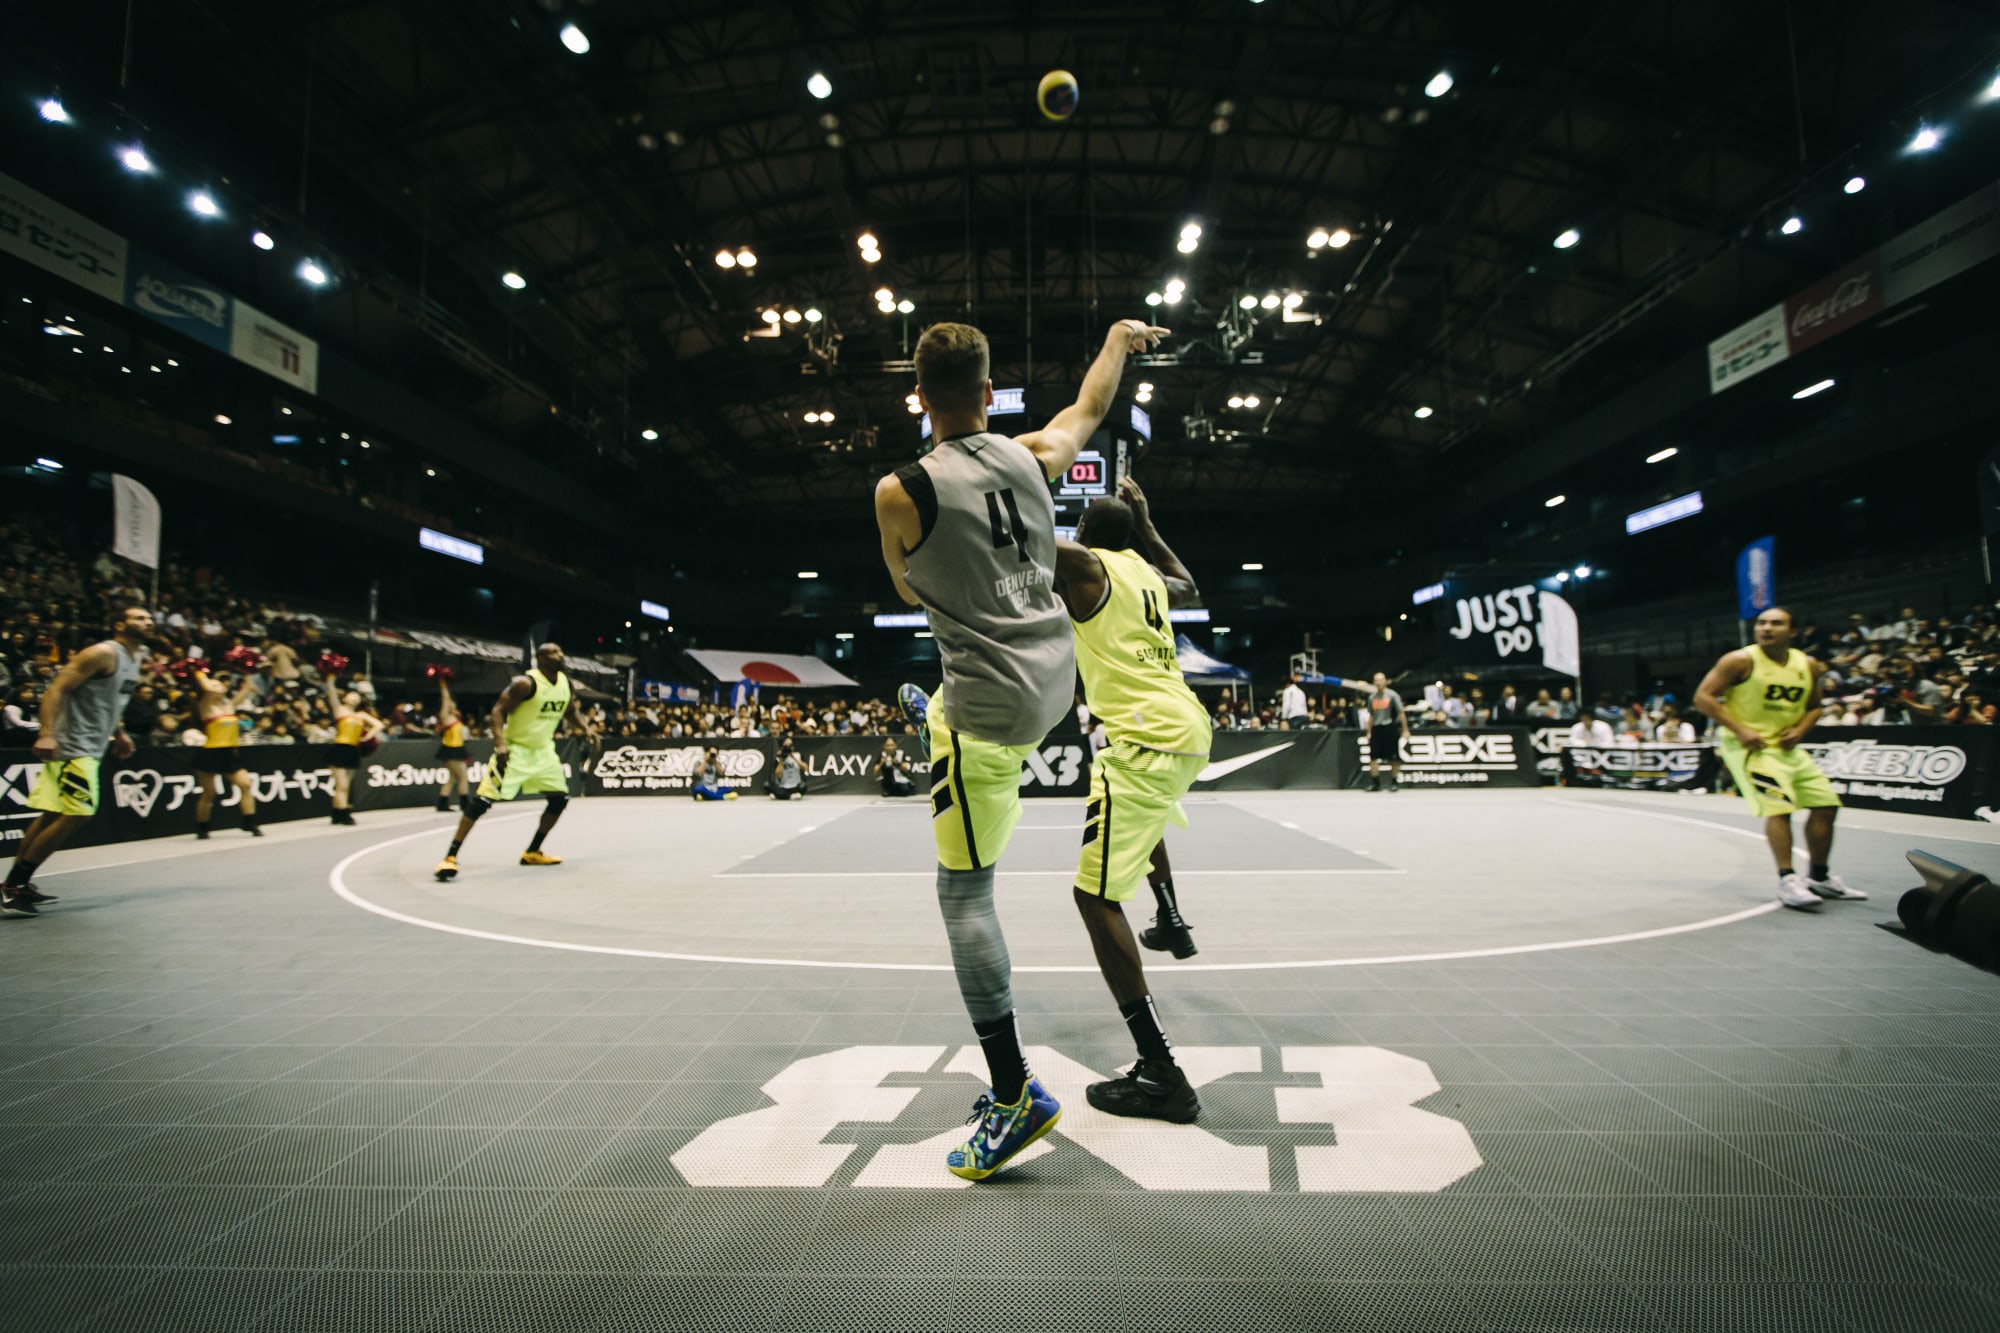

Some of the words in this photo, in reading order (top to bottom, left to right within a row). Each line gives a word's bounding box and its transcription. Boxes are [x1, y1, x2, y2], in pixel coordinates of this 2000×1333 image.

[1071, 464, 1097, 481] 01
[984, 487, 1029, 563] 4
[995, 568, 1043, 598] DENVER
[1142, 588, 1166, 639] 4
[1449, 584, 1536, 640] JUST
[1493, 625, 1533, 658] DO
[1829, 740, 1965, 785] XEBIO
[603, 778, 621, 788] We
[623, 779, 643, 788] are
[645, 777, 683, 789] Sports
